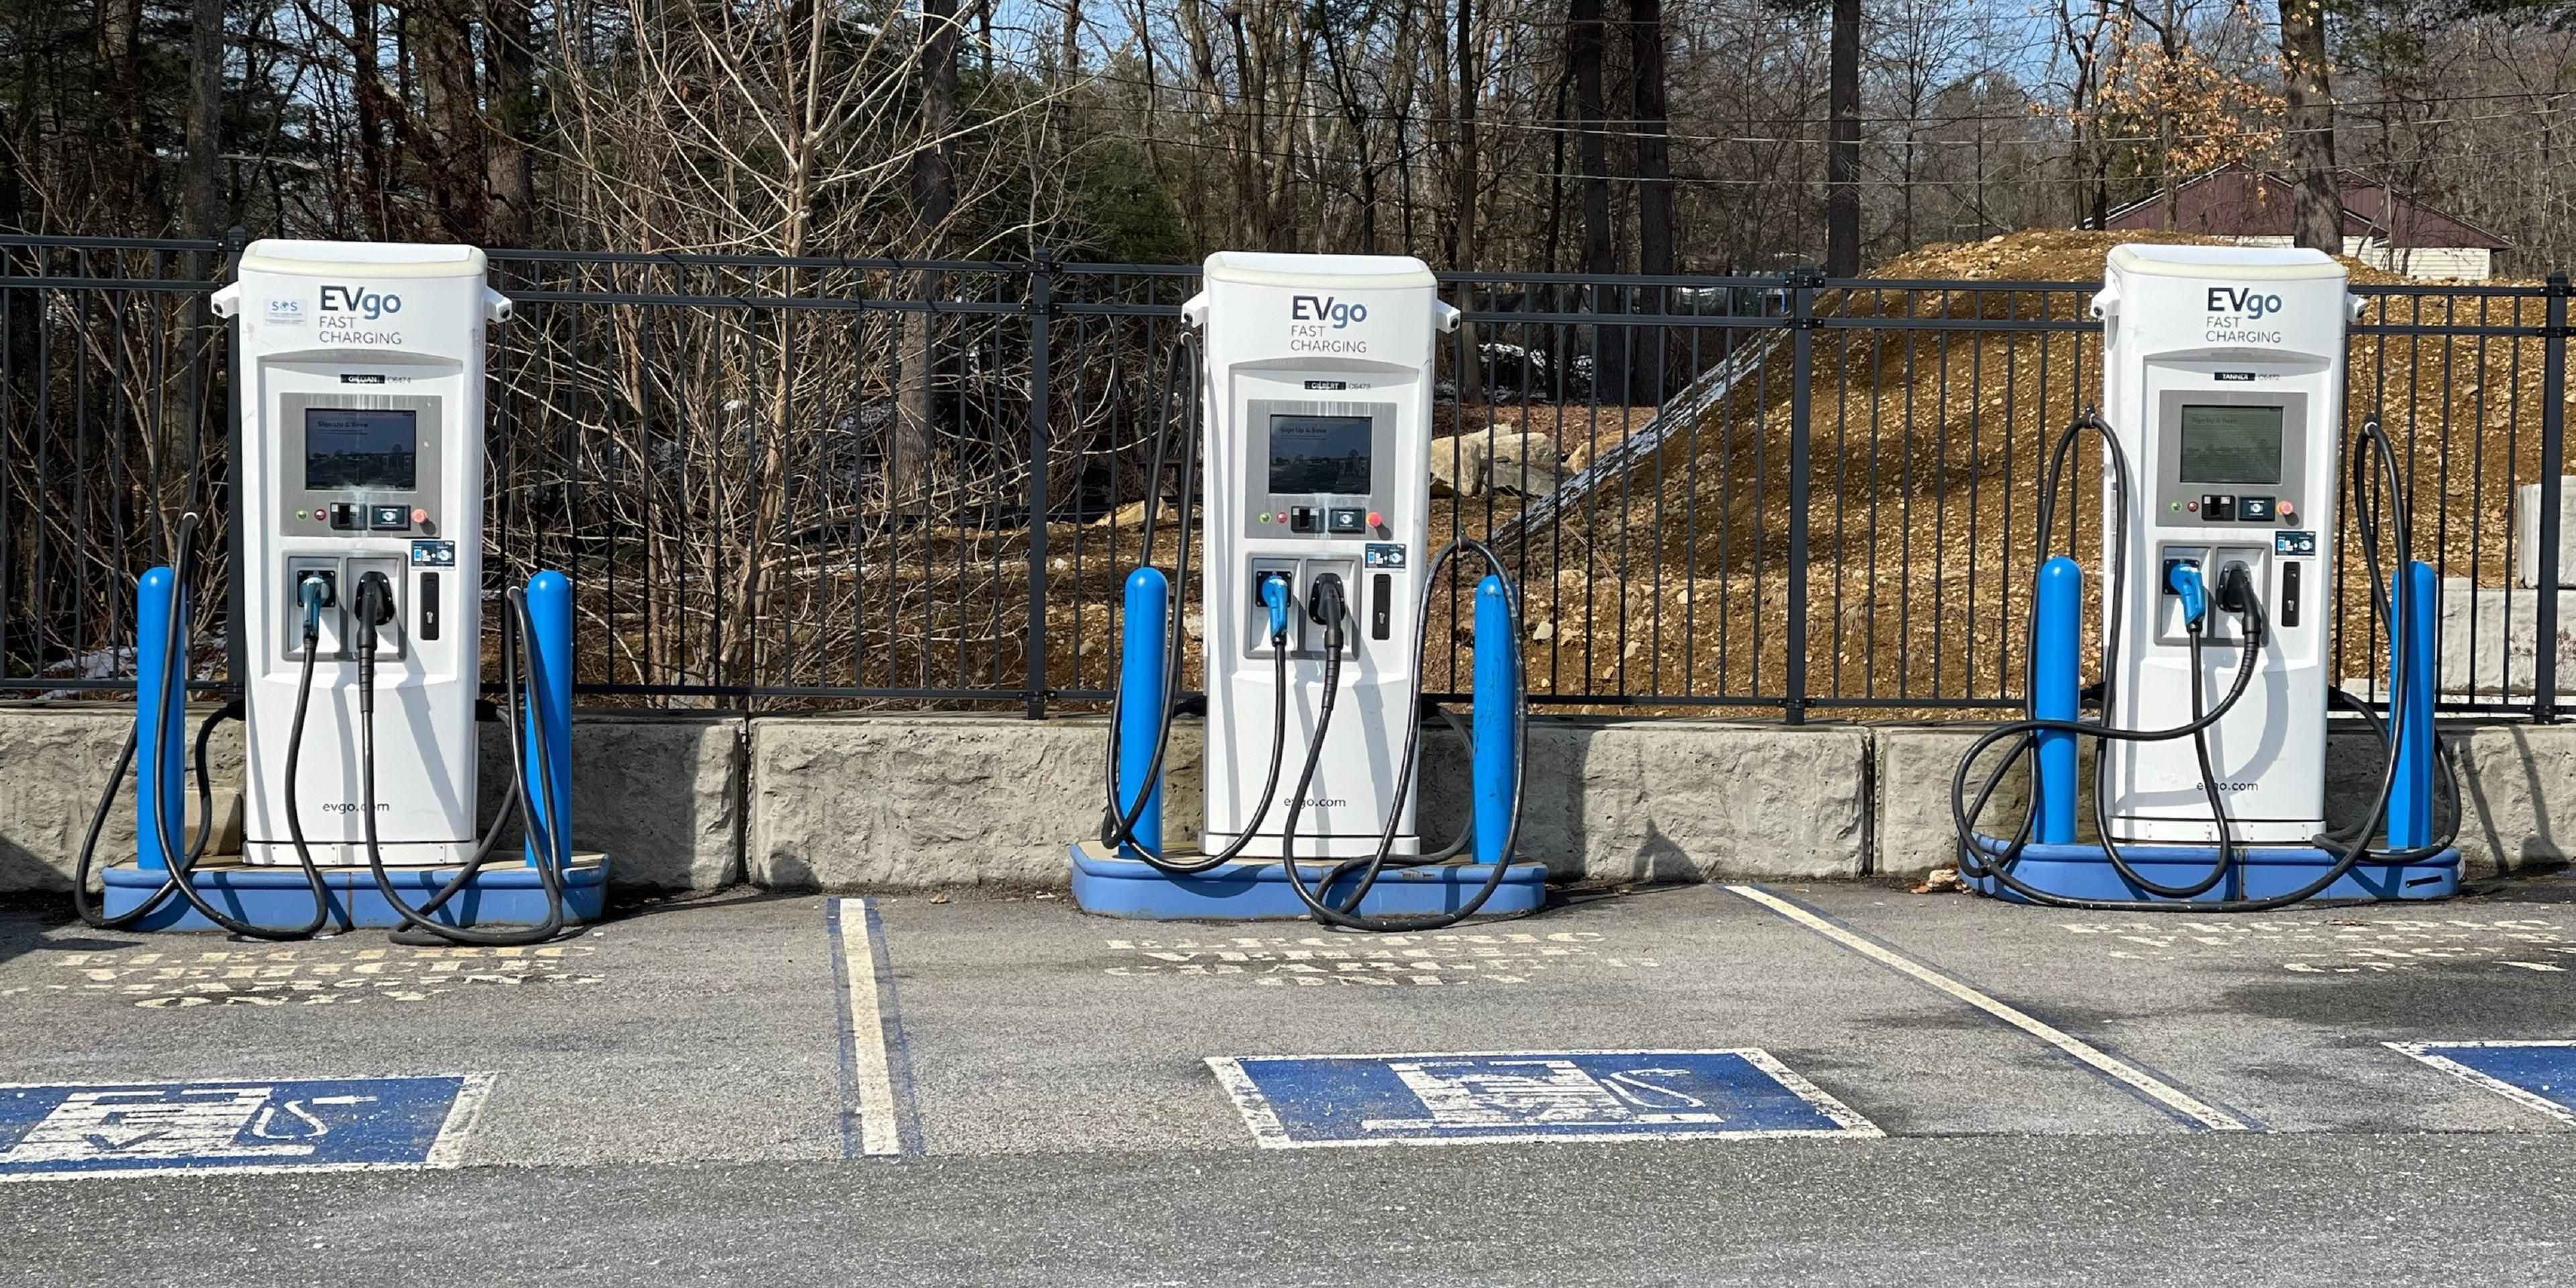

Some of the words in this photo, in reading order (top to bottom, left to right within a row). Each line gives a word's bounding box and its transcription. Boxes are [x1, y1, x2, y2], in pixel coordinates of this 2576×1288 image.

[320, 285, 401, 320] EVgo
[2208, 287, 2282, 319] EVgo
[1292, 295, 1367, 329] EVgo
[319, 316, 356, 328] FAST
[2206, 316, 2241, 328] FAST
[1291, 325, 1326, 337] FAST
[2206, 331, 2282, 343] CHARGING
[319, 331, 402, 345] CHARGING
[1291, 339, 1366, 353] CHARGING
[2196, 782, 2258, 791] eo.com
[322, 802, 389, 814] evgo.cm
[1284, 798, 1346, 809] ego.com
